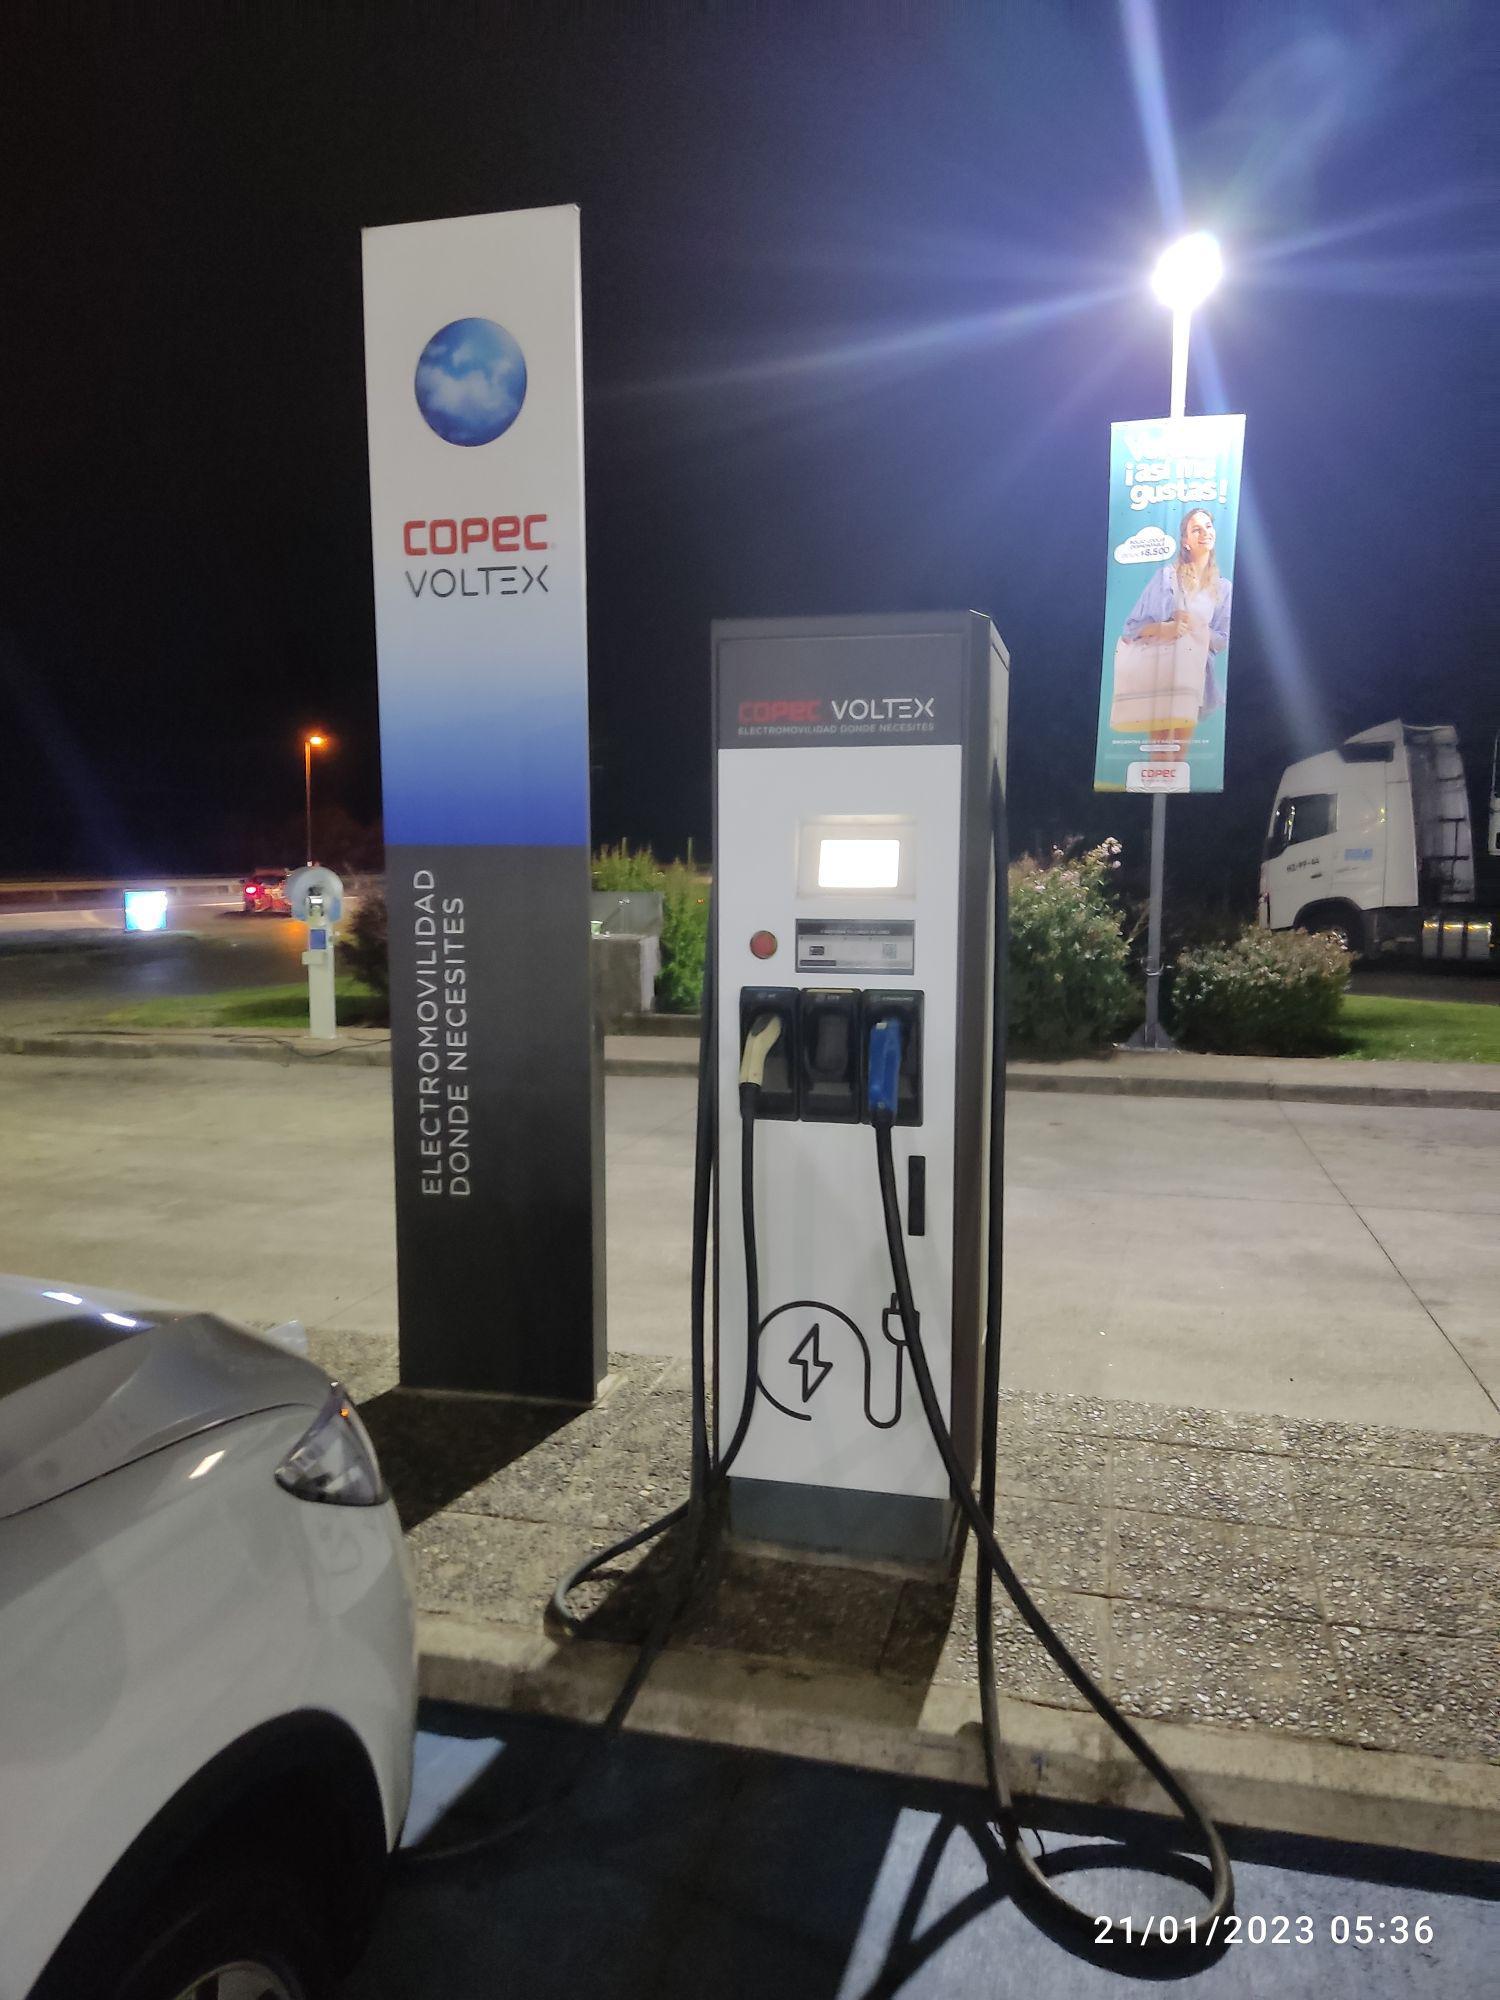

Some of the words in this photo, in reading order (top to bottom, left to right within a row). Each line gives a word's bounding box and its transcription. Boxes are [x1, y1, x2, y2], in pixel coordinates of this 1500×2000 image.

[403, 514, 548, 556] COPEC
[405, 565, 549, 598] VOLTEX
[738, 725, 837, 736] ELECTROMOVILIDAD
[840, 723, 877, 733] DONDE
[879, 722, 935, 732] NECESITES
[832, 698, 935, 720] VOLTEX
[442, 898, 467, 1070] NECESITES
[413, 870, 443, 1194] ELECTROMOVILIDAD
[447, 1085, 471, 1195] DONDE
